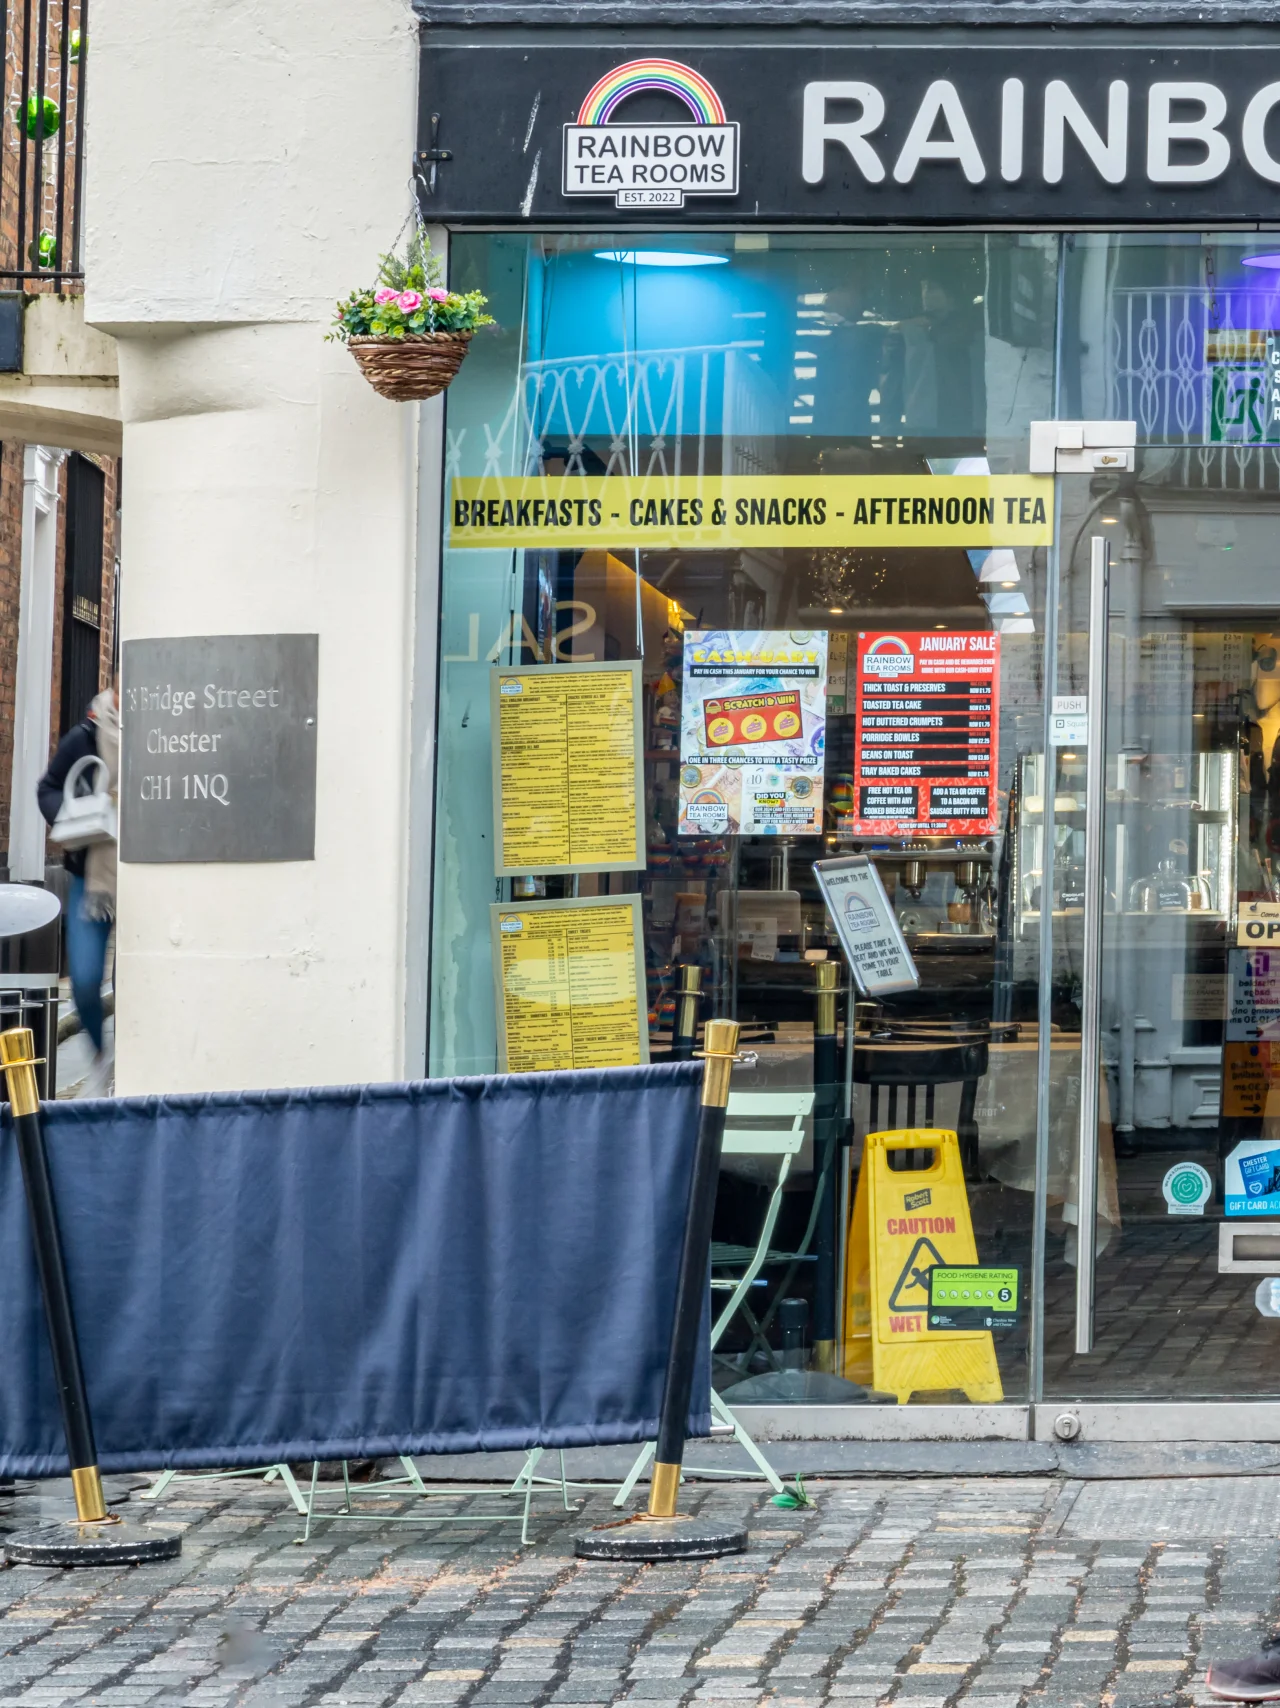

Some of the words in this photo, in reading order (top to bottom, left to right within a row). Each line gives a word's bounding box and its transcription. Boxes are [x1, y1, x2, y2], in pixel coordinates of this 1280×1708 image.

[578, 134, 725, 158] RAINBOW
[574, 164, 624, 184] TEA
[632, 163, 726, 183] ROOMS
[624, 192, 645, 202] EST.
[648, 192, 676, 202] 2022
[454, 498, 602, 526] BREAKFASTS
[630, 498, 703, 526] CAKES
[711, 498, 726, 526] &
[735, 497, 827, 526] SNACKS
[853, 497, 995, 525] AFTERNOON
[1003, 497, 1046, 524] TEA
[919, 637, 967, 651] JANUARY
[969, 637, 996, 651] SALE
[693, 650, 819, 664] CASH-UARY
[863, 683, 882, 692] THICK
[883, 683, 902, 692] TOAST
[904, 683, 909, 692] &
[910, 683, 946, 692] PRESERVES
[140, 684, 196, 716] Bridge
[203, 683, 279, 709] Street
[723, 697, 766, 711] SCRATCH
[766, 695, 775, 706] &
[776, 694, 796, 706] WIN
[862, 700, 891, 710] TOASTED
[892, 700, 904, 710] TEA
[905, 700, 922, 710] CAKE
[1057, 701, 1082, 710] PUSH
[862, 717, 875, 726] HOT
[876, 717, 908, 726] BUTTERED
[909, 717, 943, 726] CRUMPETS
[1066, 720, 1087, 728] Squar
[147, 728, 222, 754] Chester
[862, 733, 892, 742] PORRIDGE
[893, 733, 920, 742] BOWLES
[861, 750, 883, 759] BEANS
[883, 750, 892, 759] ON
[893, 750, 914, 759] TOAST
[861, 766, 877, 776] TRAY
[878, 766, 899, 776] BAKED
[900, 766, 921, 776] CAKES
[140, 774, 171, 800] CH1
[182, 774, 230, 806] 1NQ
[867, 797, 886, 805] COFFEE
[887, 797, 901, 805] WITH
[901, 797, 913, 805] ANY
[825, 875, 850, 886] WELCOME
[850, 874, 858, 882] TO
[857, 872, 869, 880] THE
[847, 910, 874, 921] RAINBOW
[850, 921, 860, 929] TEA
[854, 941, 873, 952] PLEASE
[873, 938, 887, 948] TAKE
[878, 948, 888, 957] WE
[887, 946, 901, 955] WILL
[861, 961, 877, 971] COME
[876, 959, 885, 967] TO
[884, 956, 900, 966] YOUR
[876, 968, 893, 978] TABLE
[1242, 1155, 1268, 1168] CHESTER
[1244, 1165, 1256, 1175] GIFT
[1255, 1162, 1270, 1172] CARD
[905, 1190, 929, 1204] Robert
[910, 1197, 931, 1209] Scott
[1229, 1201, 1246, 1211] GIFT
[1247, 1200, 1268, 1210] CARD
[887, 1217, 956, 1235] CAUTION
[1001, 1289, 1009, 1301] 5
[889, 1315, 922, 1333] WET
